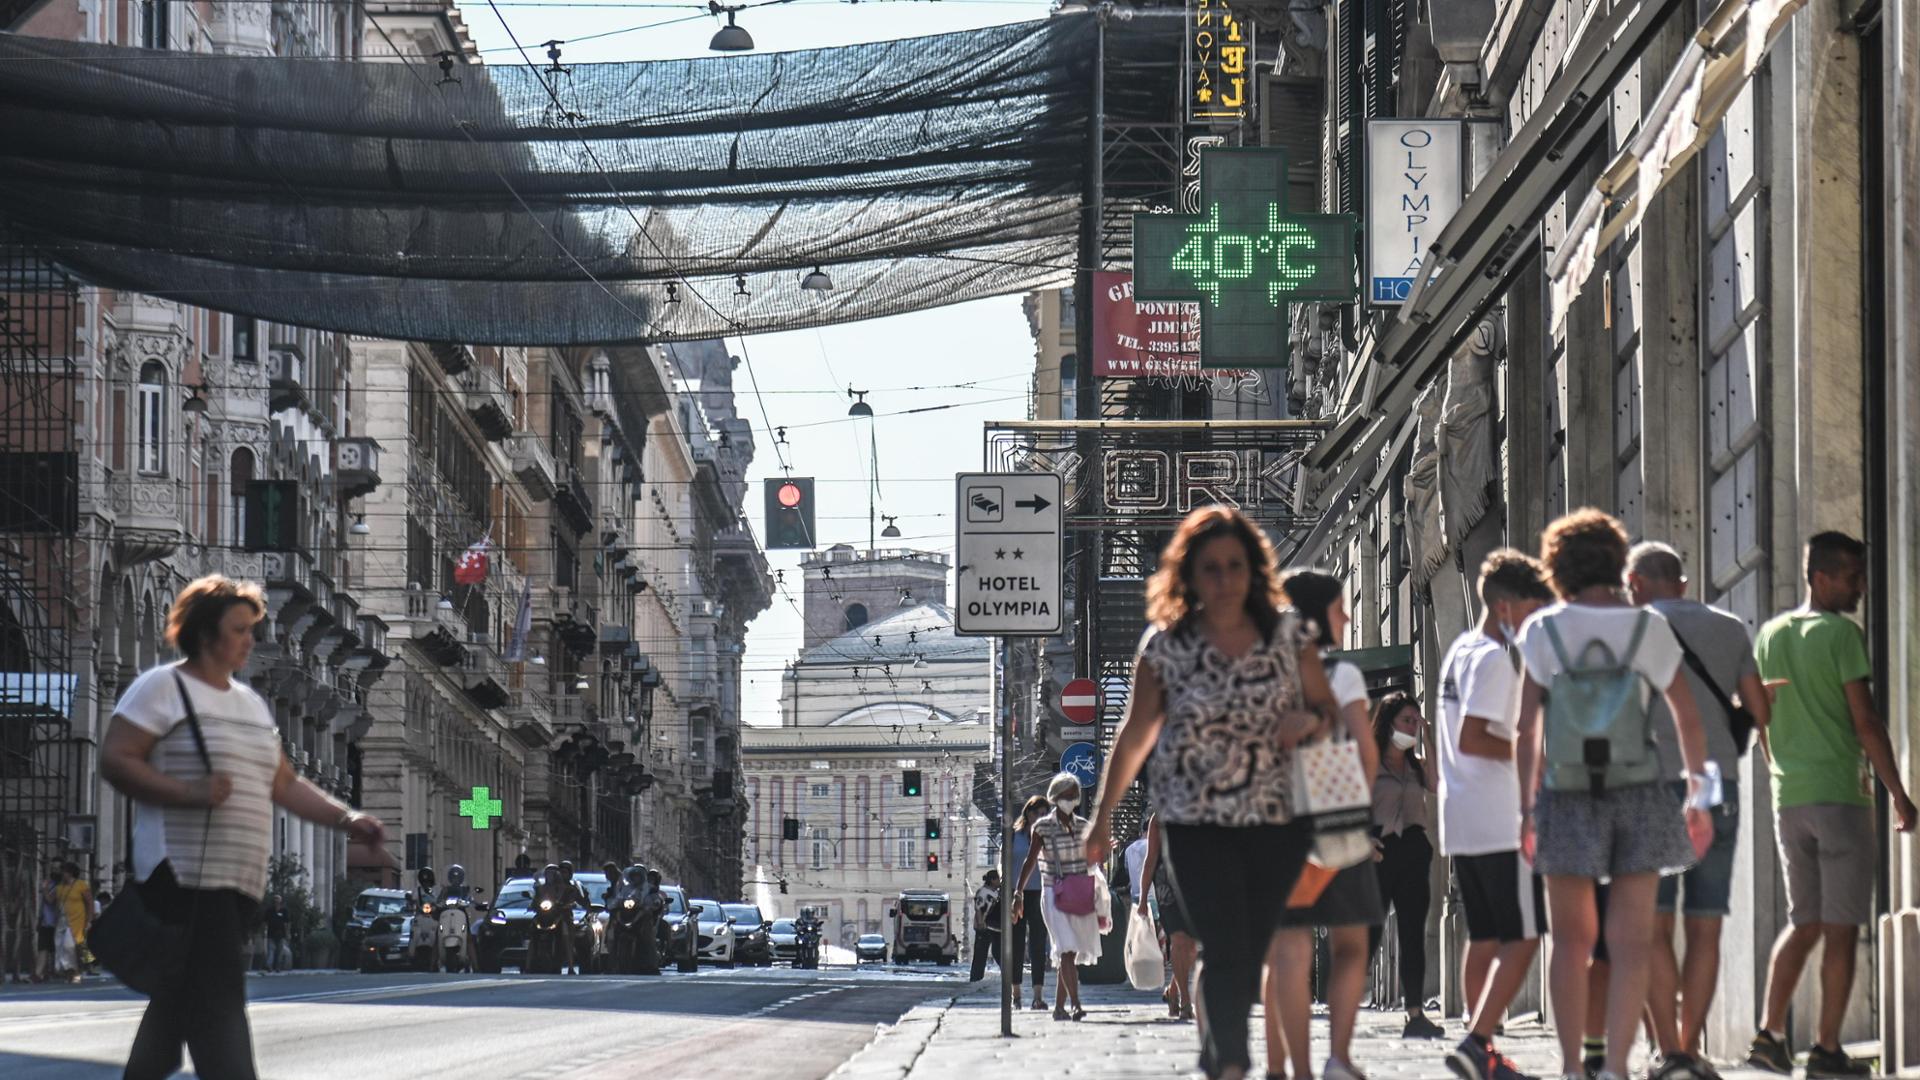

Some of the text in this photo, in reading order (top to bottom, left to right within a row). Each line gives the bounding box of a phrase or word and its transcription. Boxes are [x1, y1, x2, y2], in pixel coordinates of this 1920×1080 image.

[1400, 129, 1432, 276] OLYMPIA
[1172, 235, 1316, 278] 40°C
[1117, 334, 1144, 351] TEL.
[979, 576, 1040, 591] HOTEL
[968, 601, 1050, 616] OLYMPIA
